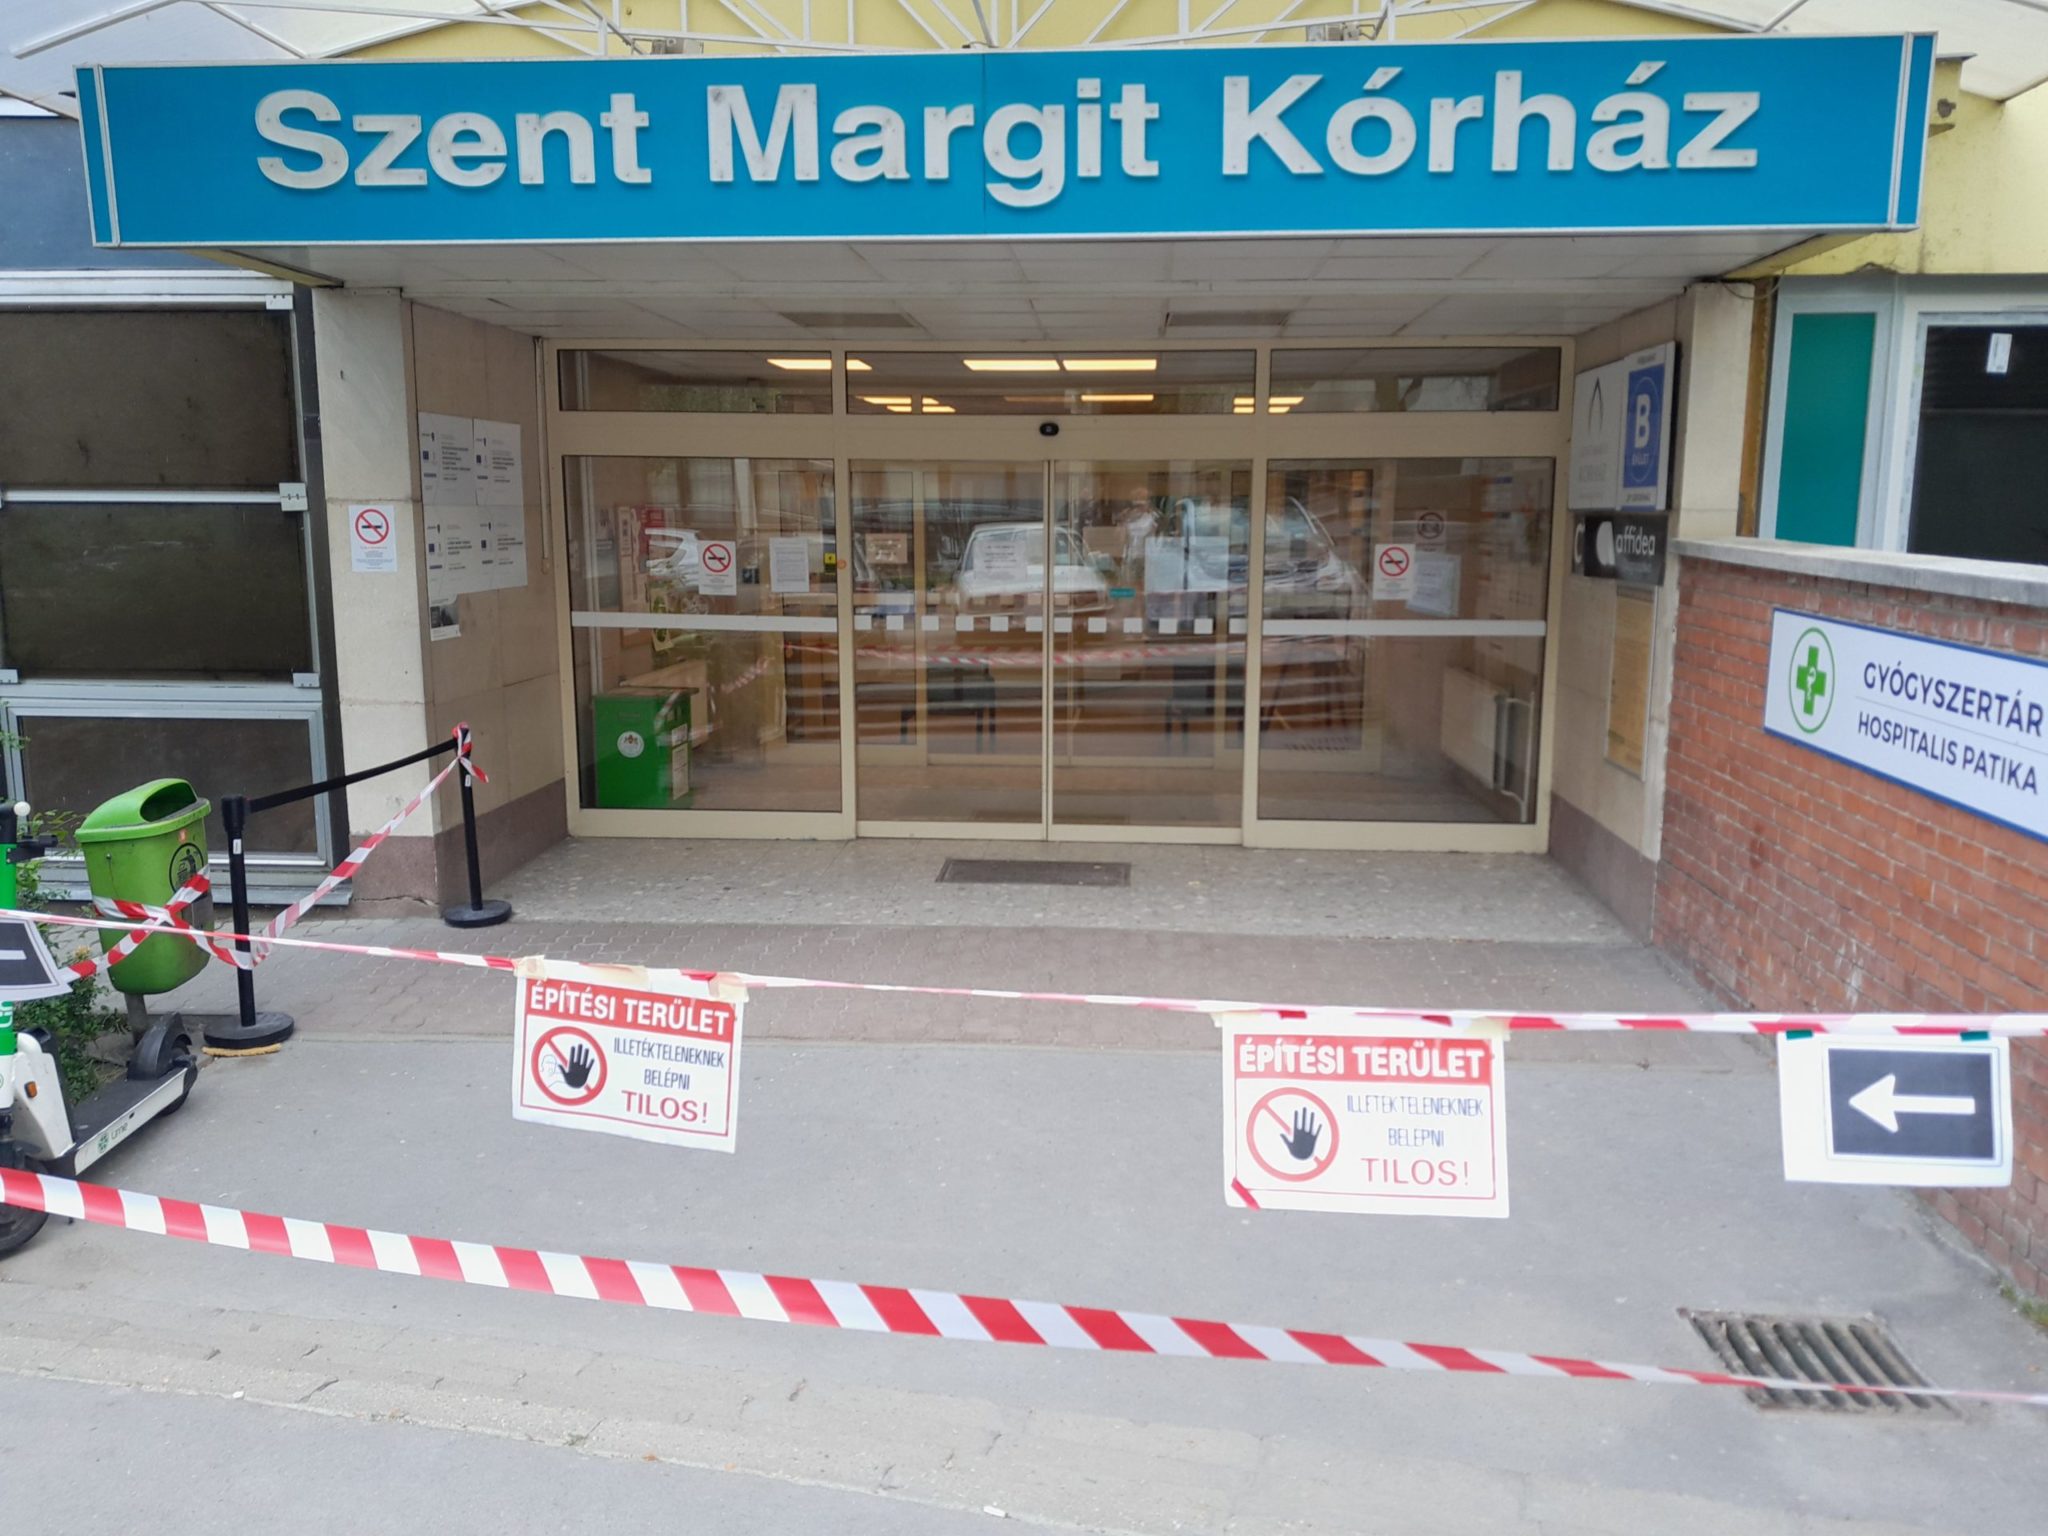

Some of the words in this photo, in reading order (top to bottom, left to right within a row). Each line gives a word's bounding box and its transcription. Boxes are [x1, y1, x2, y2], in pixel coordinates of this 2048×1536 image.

[255, 88, 652, 190] Szent
[706, 77, 1160, 208] Margit
[1221, 60, 1761, 176] Kórház
[1634, 393, 1652, 449] B
[1615, 525, 1656, 556] affidea
[1863, 660, 2044, 738] GYÓGYSZERTÁR
[1857, 711, 1958, 767] HOSPITALIS
[1961, 745, 2039, 796] PATIKA
[531, 982, 616, 1019] ÉPÍTÉSI
[624, 1000, 729, 1035] TERÜLET
[643, 1067, 691, 1091] BELÉPNI
[1239, 1036, 1345, 1075] ÉPÍTÉSI
[1352, 1040, 1485, 1079] TERÜLET
[621, 1089, 708, 1124] TILOS!
[1360, 1157, 1471, 1187] TILOS!
